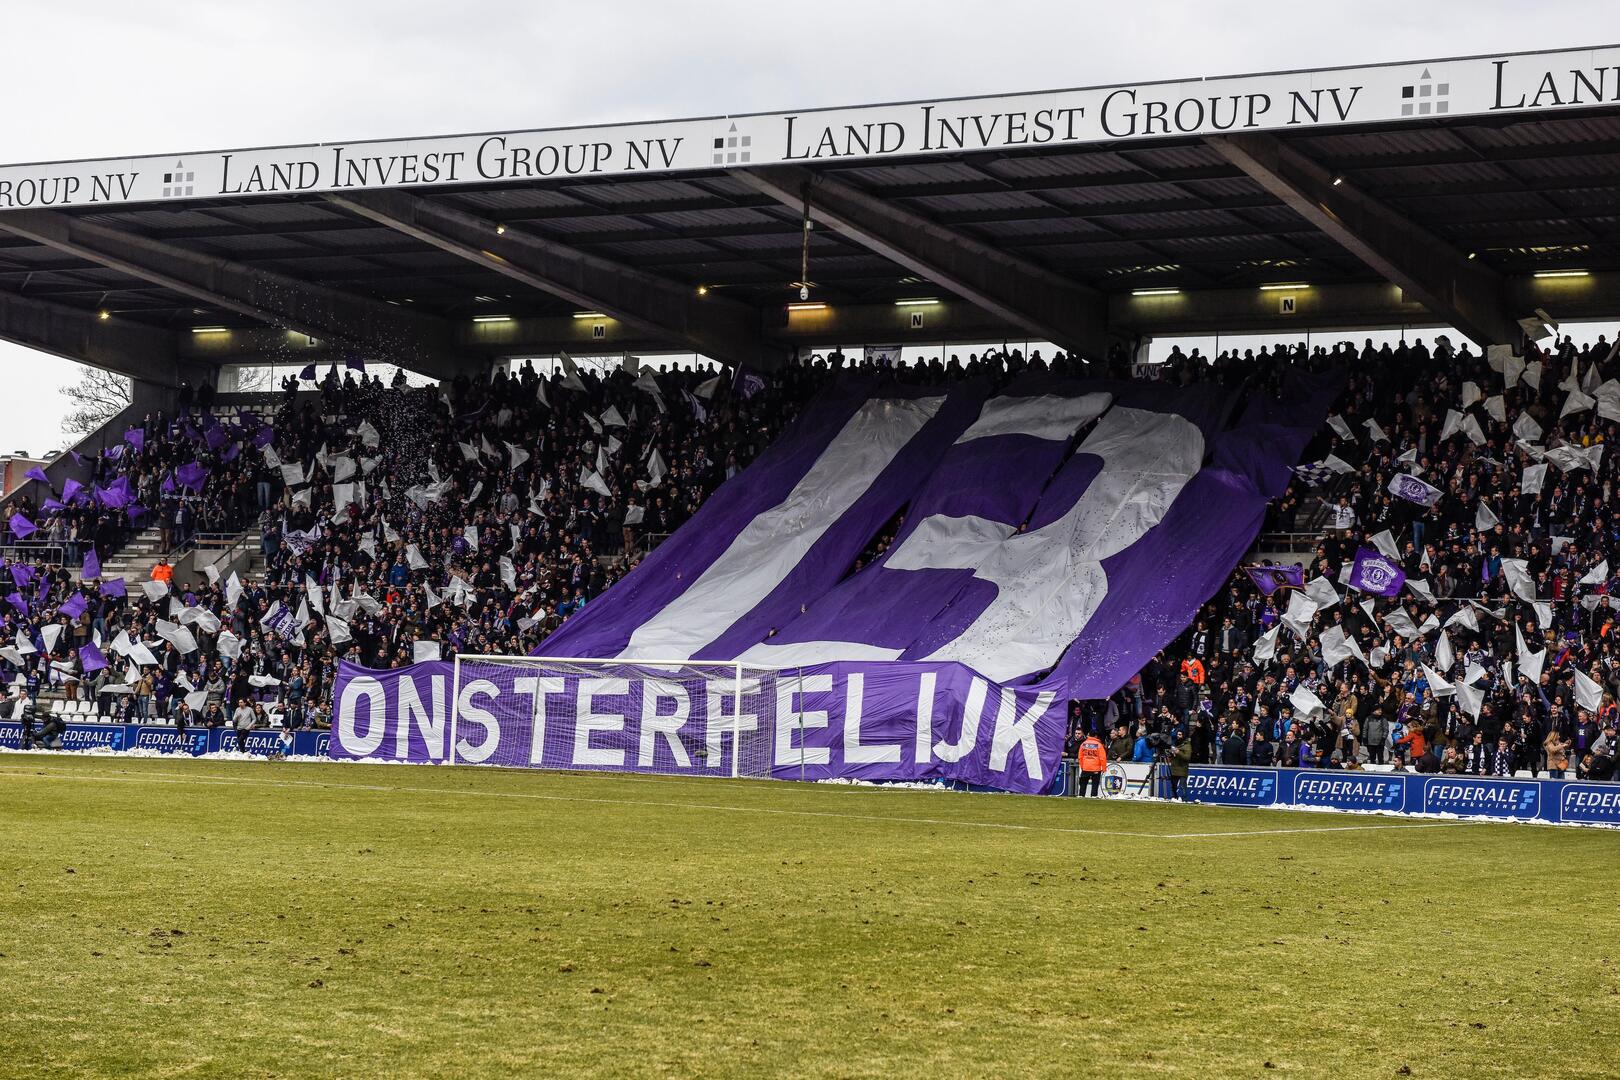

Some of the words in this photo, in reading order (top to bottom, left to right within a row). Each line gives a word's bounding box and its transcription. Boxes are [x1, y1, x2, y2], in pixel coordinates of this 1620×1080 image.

[781, 116, 905, 161] LAND
[919, 105, 1085, 151] INVEST
[1100, 89, 1271, 138] GROUP
[1286, 86, 1363, 125] NV
[218, 154, 320, 194] LAND
[330, 147, 465, 188] INVEST
[476, 136, 613, 180] GROUP
[623, 137, 684, 171] NV
[0, 176, 80, 207] ROUP
[89, 172, 140, 202] NV
[1283, 299, 1294, 311] N
[913, 314, 922, 326] N
[594, 326, 604, 337] M
[338, 672, 1057, 781] ONSTERFELIJK
[223, 736, 281, 749] FEERALE
[1298, 780, 1386, 796] FEDERALE
[1429, 785, 1520, 803] FEDERALE
[1565, 792, 1620, 807] FEDER
[1564, 806, 1620, 814] Verzek
